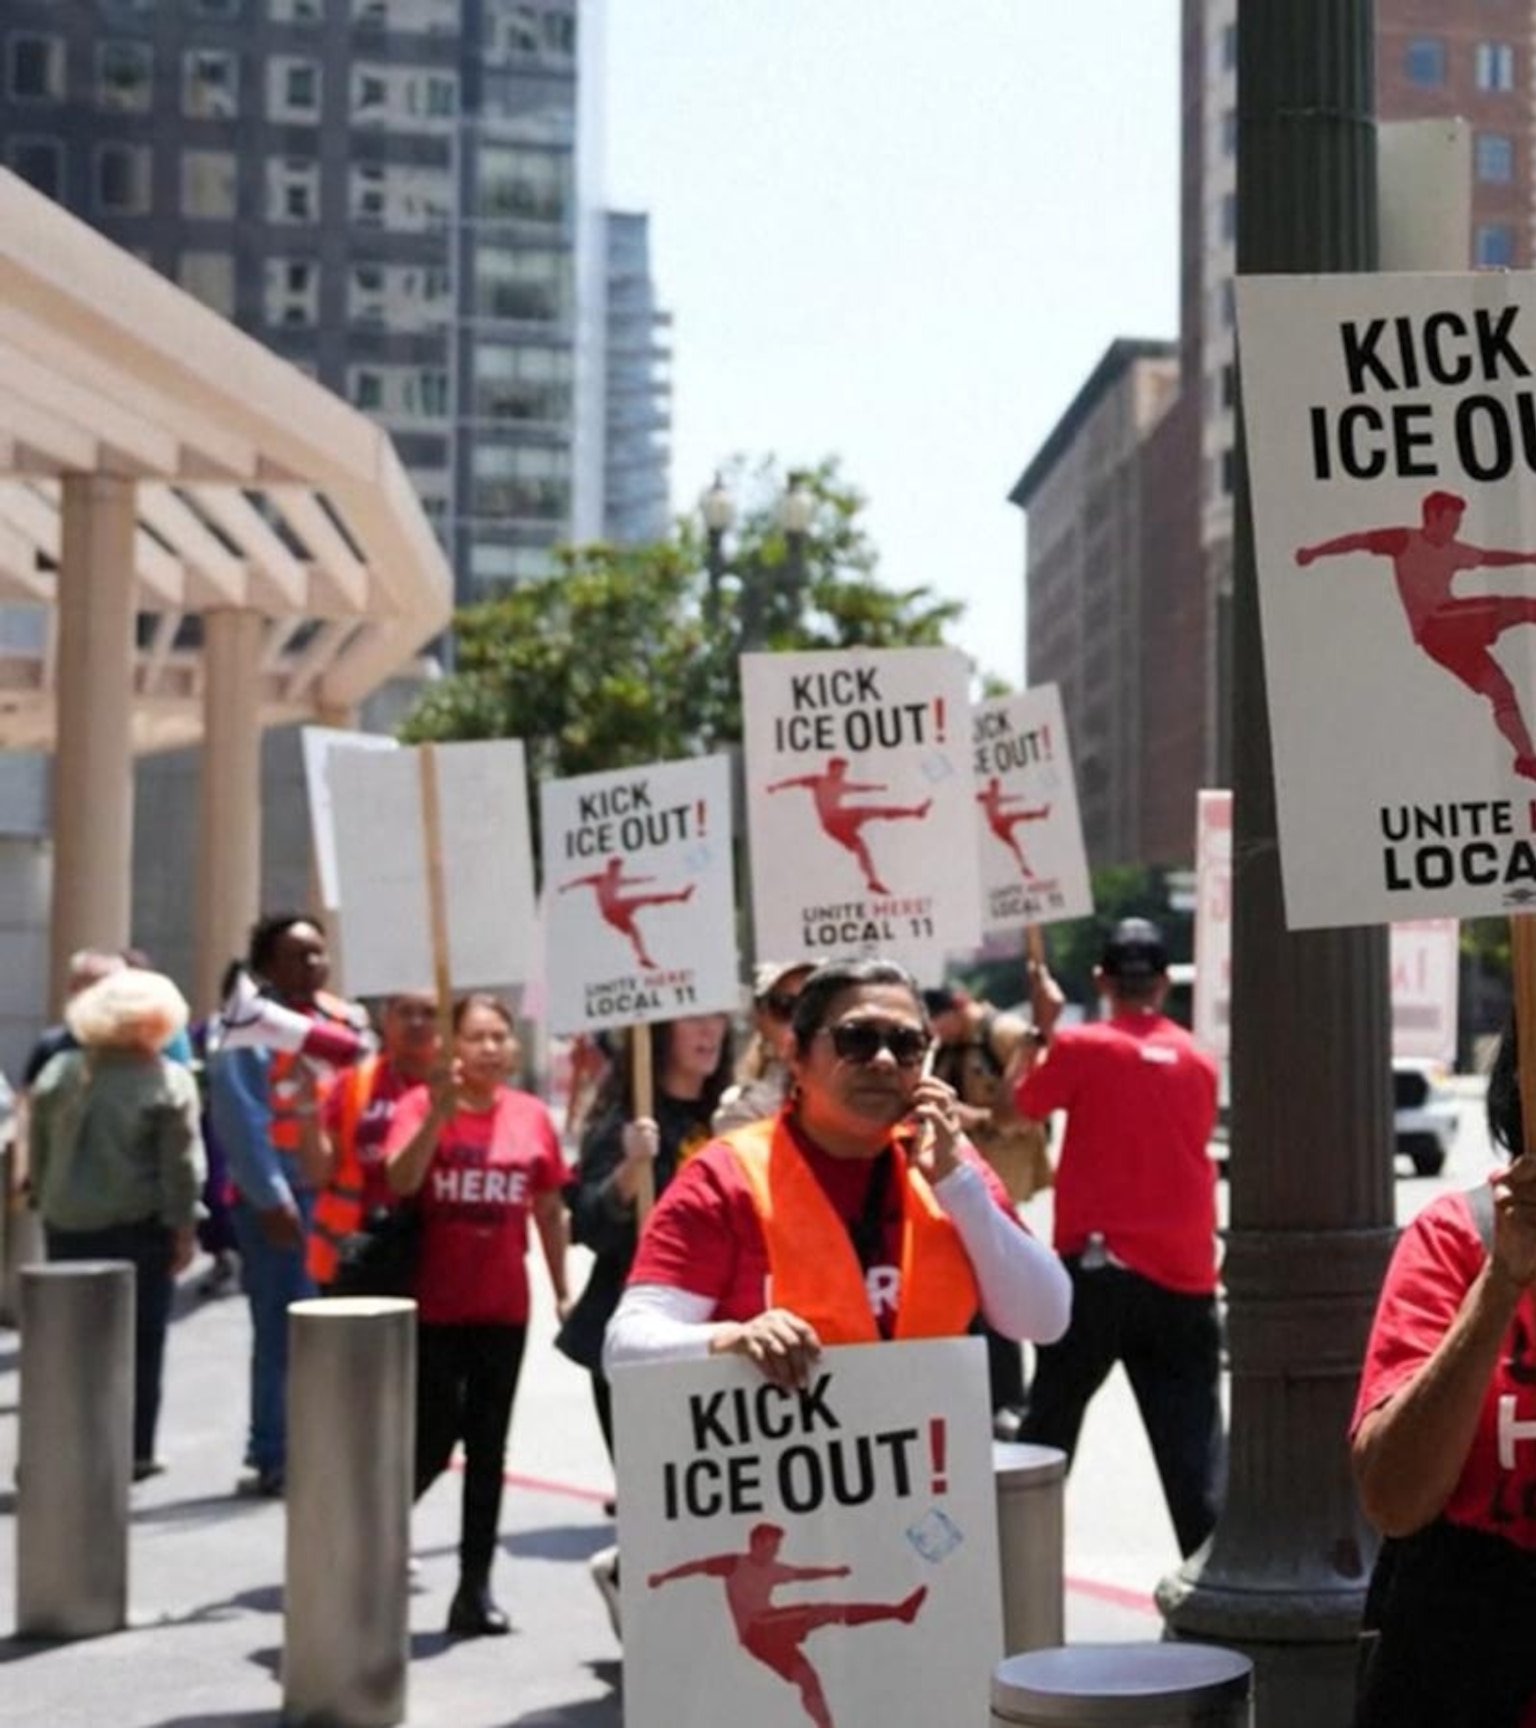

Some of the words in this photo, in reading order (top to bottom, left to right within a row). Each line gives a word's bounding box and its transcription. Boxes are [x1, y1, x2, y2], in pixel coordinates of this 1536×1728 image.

[1340, 305, 1532, 393] KICK
[1310, 403, 1438, 480] ICE
[790, 667, 882, 712] KICK
[774, 713, 834, 754] ICE
[844, 697, 947, 752] OUT!
[994, 724, 1053, 772] OUT!
[579, 781, 652, 824] KICK
[1380, 801, 1514, 841] UNITE
[566, 824, 614, 859] ICE
[621, 799, 707, 851] OUT!
[802, 921, 896, 947] LOCAL
[910, 917, 934, 939] 11
[586, 992, 664, 1018] LOCAL
[674, 986, 698, 1004] 11
[433, 1168, 529, 1204] HERE
[689, 1373, 841, 1452] KICK
[663, 1456, 763, 1521] ICE
[776, 1416, 949, 1516] OUT!
